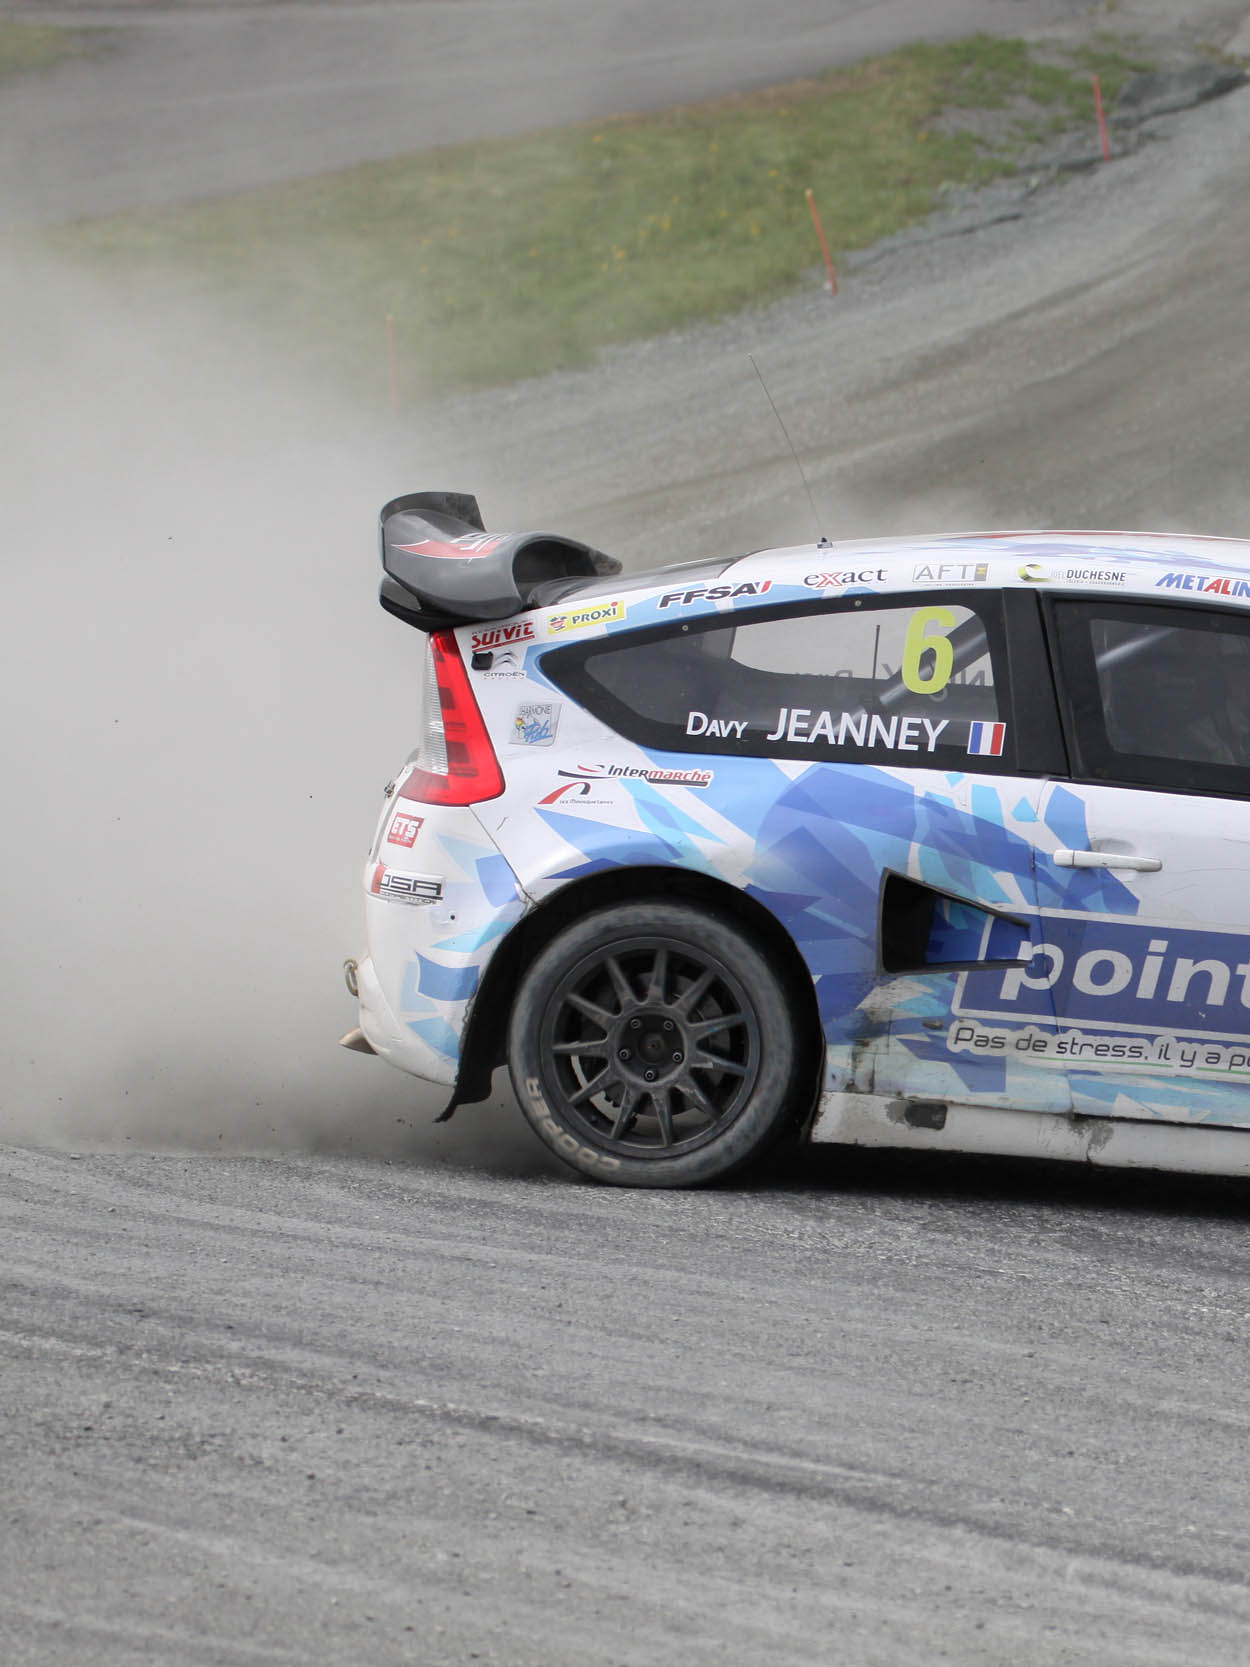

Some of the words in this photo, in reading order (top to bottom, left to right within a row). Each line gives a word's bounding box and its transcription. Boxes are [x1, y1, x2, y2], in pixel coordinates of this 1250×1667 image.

[658, 582, 765, 609] FFSA
[1066, 569, 1126, 582] DUCHESNE
[902, 606, 955, 694] 6
[767, 708, 950, 752] JEANNEY
[954, 1027, 1007, 1049] Pas
[1015, 1033, 1048, 1052] de
[1158, 1043, 1171, 1061] il
[1180, 1049, 1197, 1068] y
[1205, 1052, 1221, 1065] a
